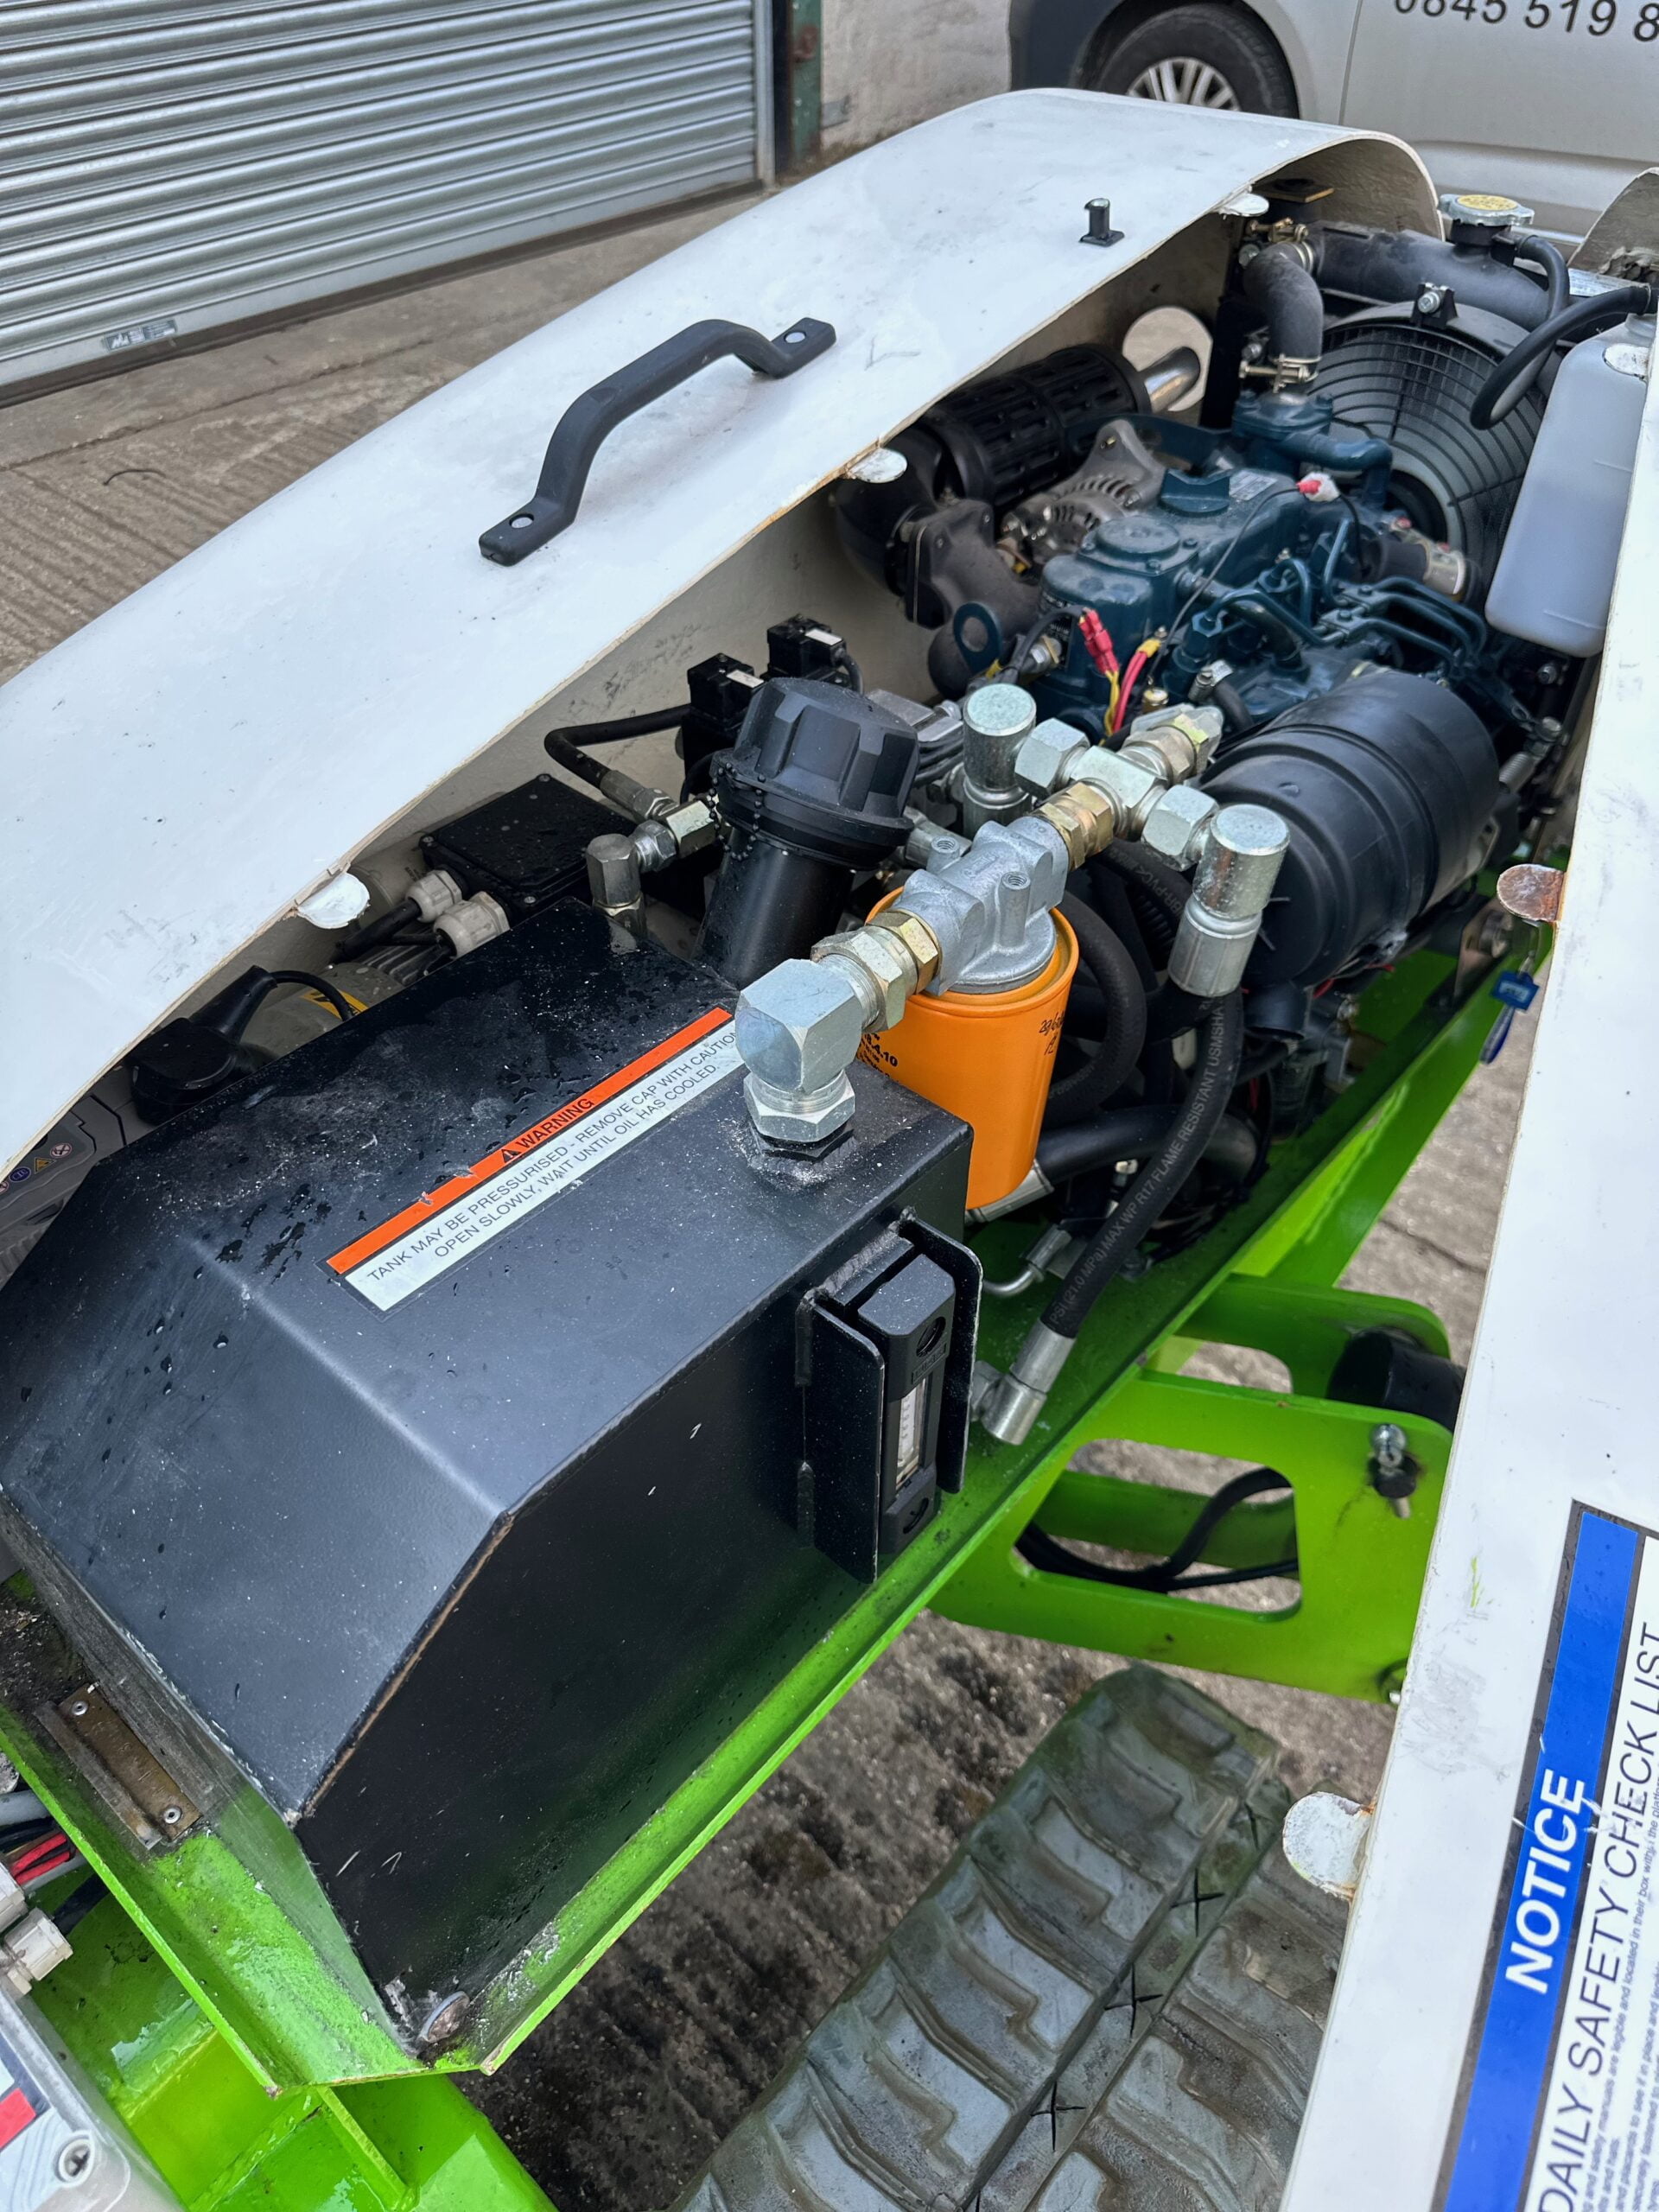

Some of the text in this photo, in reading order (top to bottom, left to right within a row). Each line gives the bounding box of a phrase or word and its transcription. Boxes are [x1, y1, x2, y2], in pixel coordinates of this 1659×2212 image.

[1524, 0, 1617, 36] 519
[516, 1098, 595, 1149] WARNING
[366, 1250, 412, 1281] TANK
[410, 1227, 444, 1254] MAY
[444, 1212, 470, 1231] BE
[468, 1146, 569, 1215] PRESSURISED
[575, 1103, 633, 1143] REMOVE
[632, 1084, 658, 1106] CAP
[657, 1064, 691, 1088] WITH
[434, 1224, 480, 1257] OPEN
[479, 1185, 542, 1228] SLOWLY,
[537, 1159, 575, 1186] WAIT
[573, 1135, 616, 1162] UNTIL
[614, 1117, 639, 1135] OIL
[636, 1098, 666, 1120] HAS
[1049, 1304, 1069, 1325] PSI
[1082, 1249, 1108, 1278] MPa)
[1101, 1222, 1126, 1249] MAX
[1121, 1202, 1139, 1224] WP
[1135, 1180, 1155, 1205] R17
[1150, 1141, 1185, 1183] FLAME
[1177, 1067, 1217, 1142] RESISTANT
[1647, 1820, 1658, 1839] the
[1505, 1769, 1586, 1994] NOTICE
[1637, 1876, 1649, 1898] box
[1538, 1622, 1659, 2212] DAILY SAFETY CHECK LIST
[1633, 1899, 1646, 1926] their
[1623, 1940, 1639, 1986] located
[1619, 1986, 1631, 2012] and
